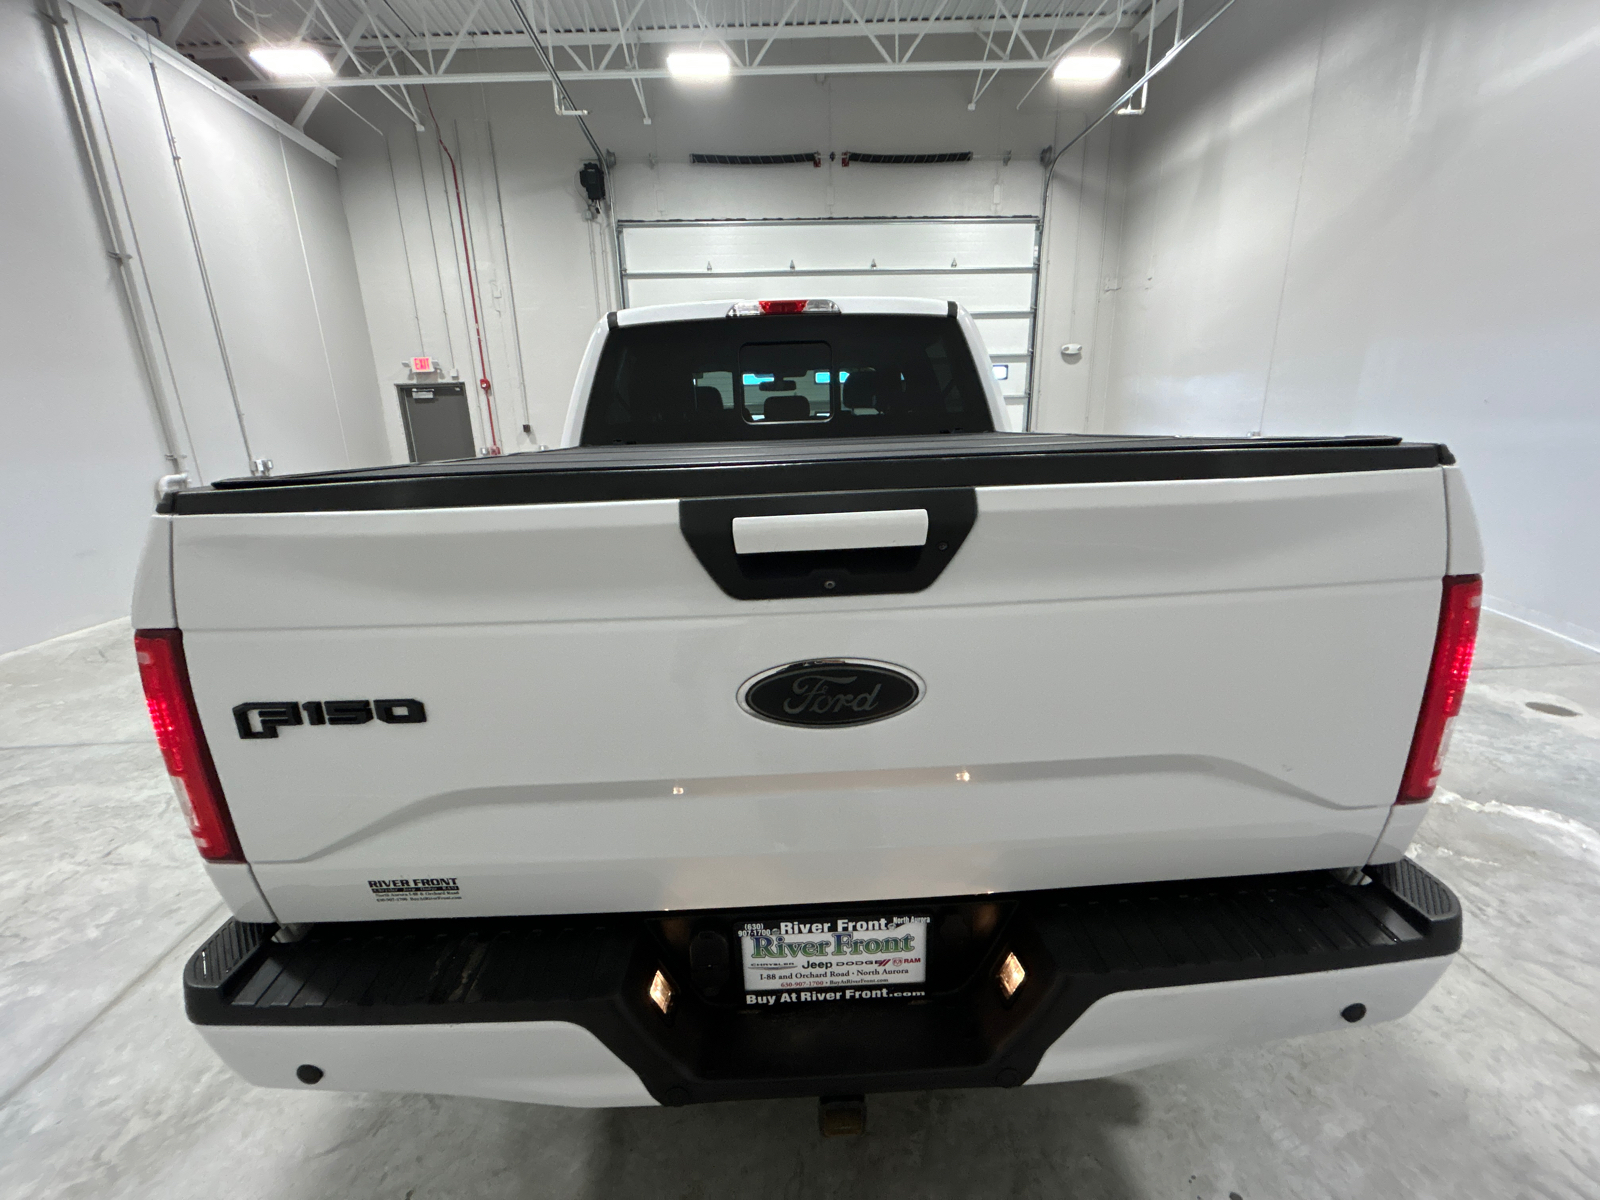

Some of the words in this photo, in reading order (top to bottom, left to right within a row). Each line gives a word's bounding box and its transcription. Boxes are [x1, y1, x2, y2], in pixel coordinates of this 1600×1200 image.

[413, 357, 431, 370] EXIT
[782, 675, 883, 715] Ford
[367, 879, 411, 888] RIVER
[412, 877, 458, 886] FRONT
[893, 916, 909, 924] North
[910, 915, 931, 923] Aurora
[744, 923, 764, 931] (630)
[780, 921, 831, 935] River
[837, 918, 887, 932] Front
[738, 929, 771, 937] 907-1700
[750, 935, 831, 959] River
[831, 931, 915, 956] Front
[801, 960, 833, 969] Jeep
[836, 959, 881, 967] DODGE
[760, 973, 776, 981] I-88
[778, 972, 793, 980] and
[795, 971, 827, 979] Orchard
[856, 968, 880, 976] North
[745, 994, 776, 1006] Buy
[780, 992, 797, 1003] At
[800, 991, 842, 1002] River
[845, 988, 926, 1000] Front.com
